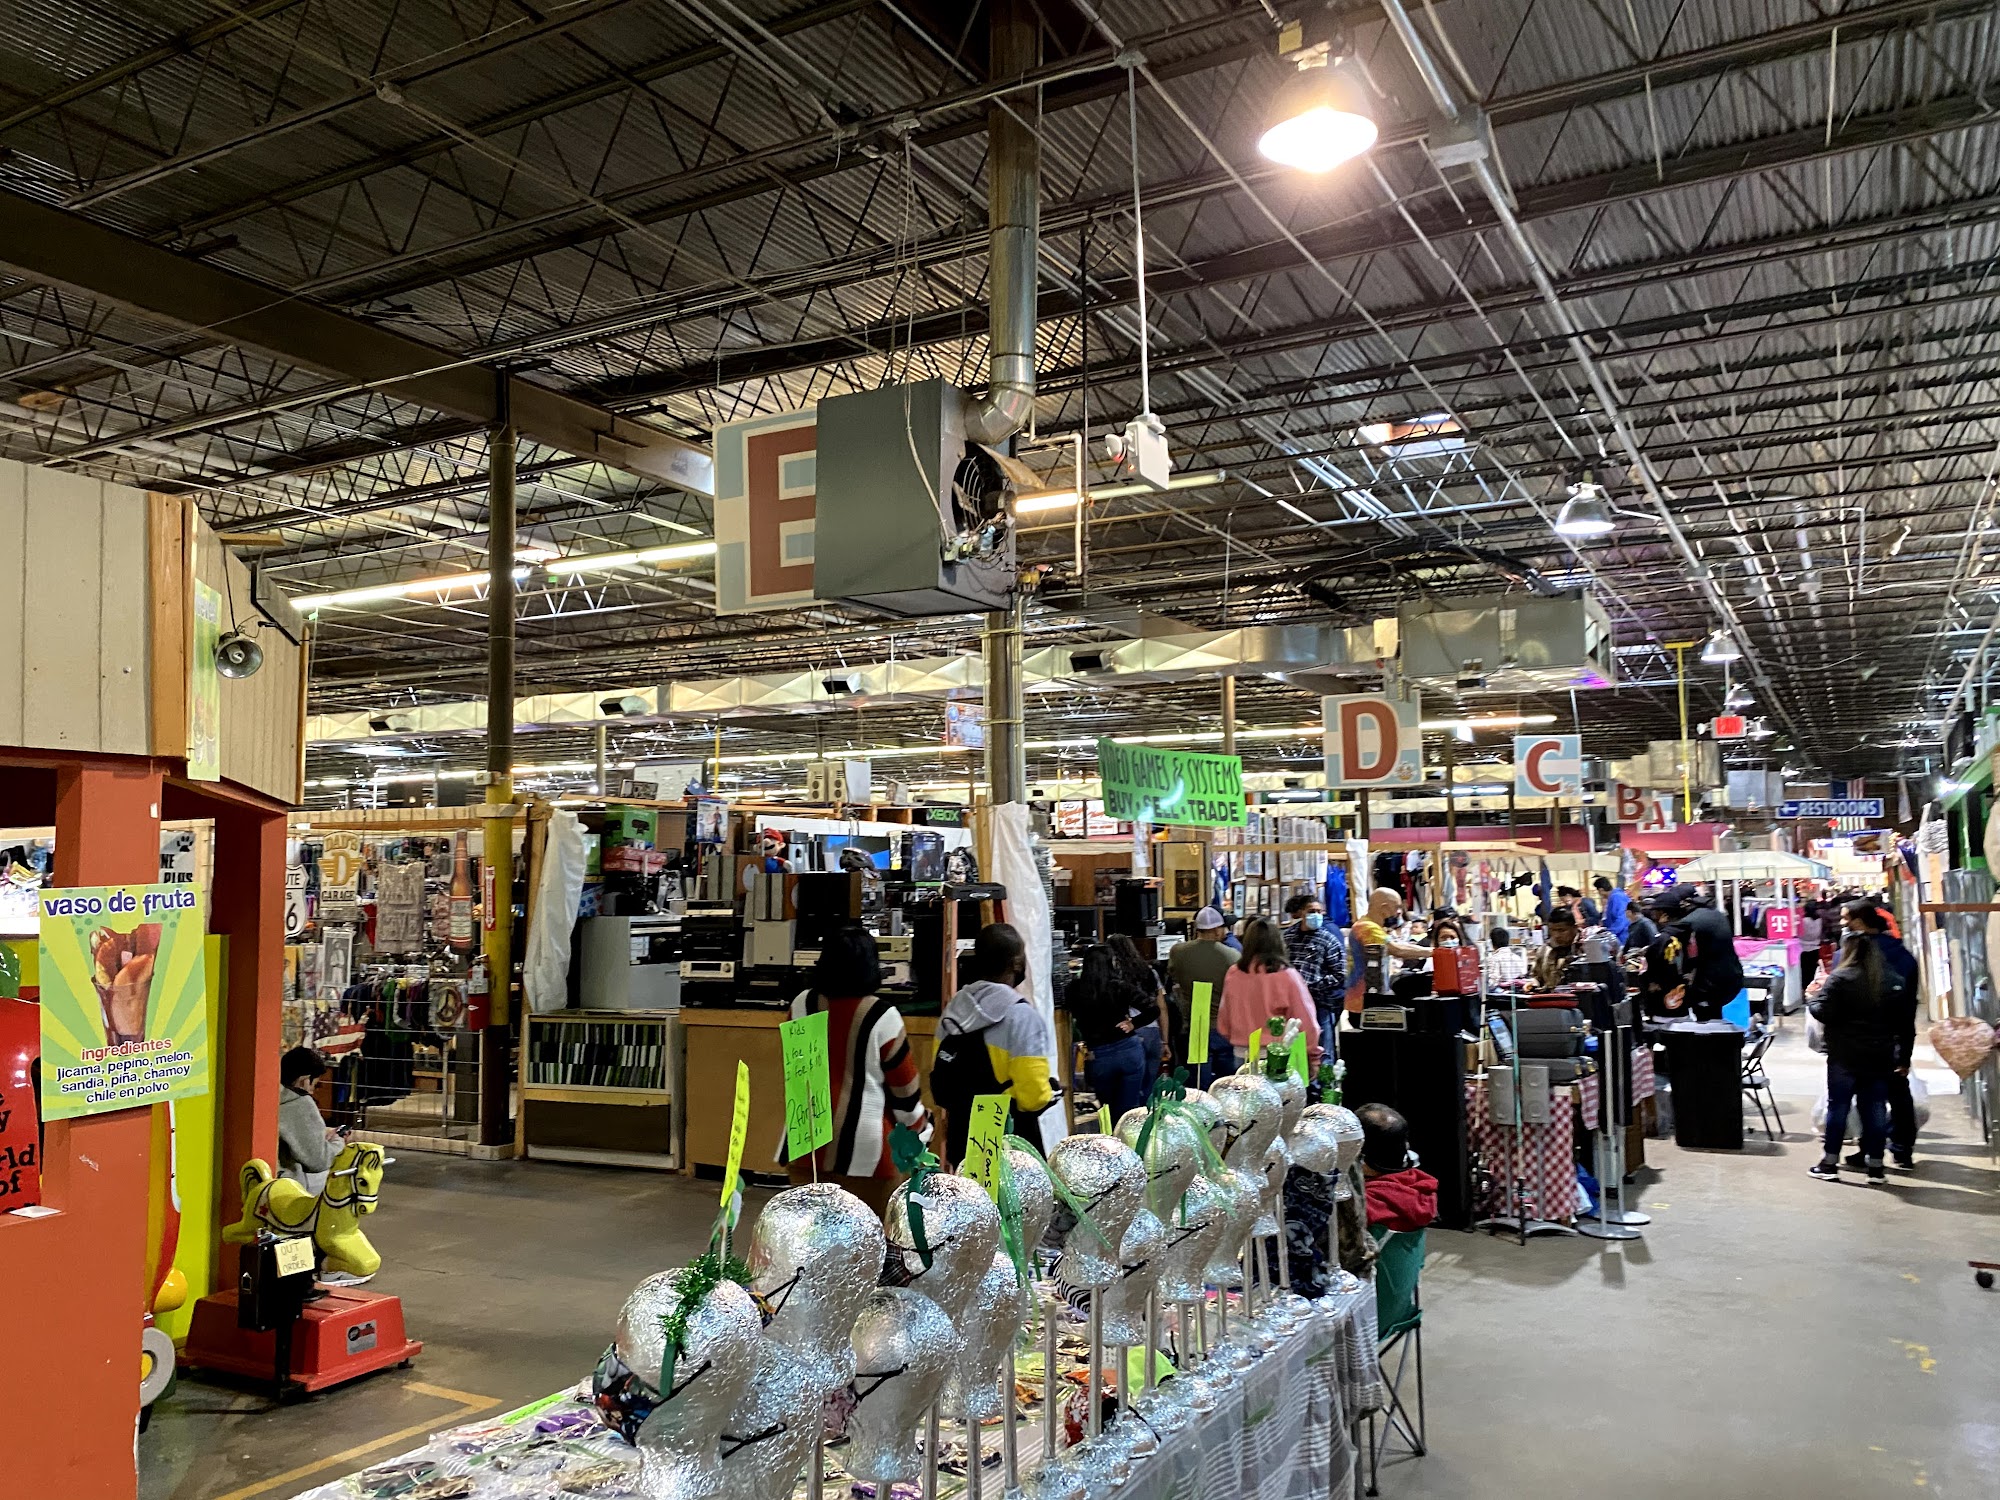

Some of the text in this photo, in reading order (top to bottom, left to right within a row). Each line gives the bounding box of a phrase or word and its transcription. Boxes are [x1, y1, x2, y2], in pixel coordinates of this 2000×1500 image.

[745, 423, 817, 599] E
[1340, 700, 1399, 781] D
[1131, 750, 1170, 792] GAMES
[1172, 756, 1184, 783] &
[1187, 758, 1240, 797] SYSTEMS
[1526, 740, 1562, 793] C
[927, 808, 960, 822] XBOX
[1107, 788, 1240, 822] BUY SELL TRADE
[1616, 783, 1646, 821] B
[1798, 801, 1878, 816] RESTROOMS
[1643, 800, 1666, 832] A
[45, 889, 196, 916] vaso de fruta
[321, 889, 356, 901] GARAGE
[286, 903, 298, 931] 6
[81, 1037, 172, 1062] ingredientes
[108, 1056, 153, 1075] pepino,
[155, 1051, 194, 1066] melon,
[61, 1064, 191, 1093] sandia, piña, chamoy
[86, 1082, 170, 1104] chile en polvo
[281, 1242, 300, 1256] OUT
[282, 1260, 308, 1274] ORDER
